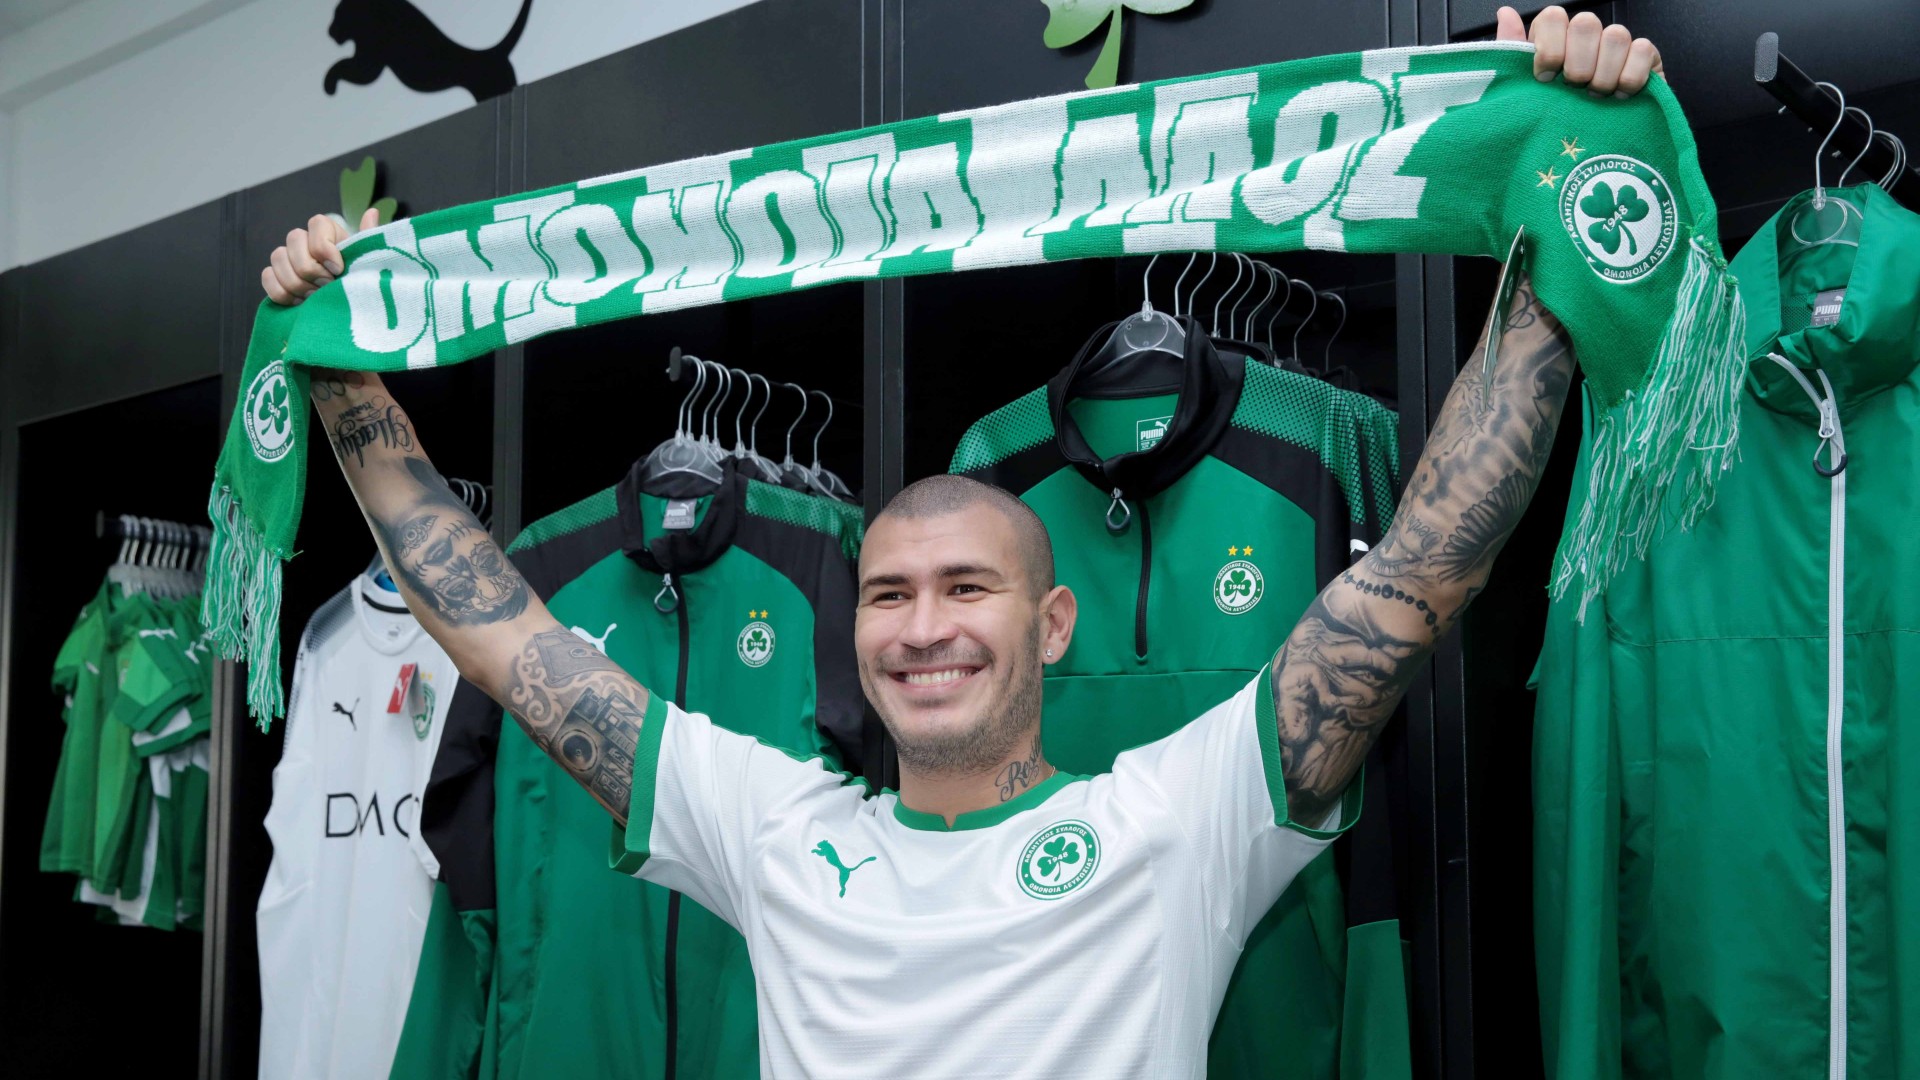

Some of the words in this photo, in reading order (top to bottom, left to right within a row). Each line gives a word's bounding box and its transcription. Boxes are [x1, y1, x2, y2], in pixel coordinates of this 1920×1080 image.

[1582, 160, 1636, 179] ΣΥΛΛΟΓΟΣ
[1602, 204, 1629, 233] 1948
[1603, 261, 1651, 279] ΟΜΟΝΟΙΑ
[1649, 199, 1674, 265] ΛΕΥΚΩΣΙΑΣ
[1140, 427, 1164, 440] PUMA
[1024, 830, 1055, 863] ΑΘΛΗΤΙΚΟΣ
[1055, 826, 1088, 837] ΣΥΛΛΟΓΟΣ
[1047, 851, 1069, 865] 1948
[1028, 883, 1062, 894] ΟΜΟΝΟΙΑ
[1063, 857, 1094, 891] ΛΕΥΚΩΣΙΑΣ
